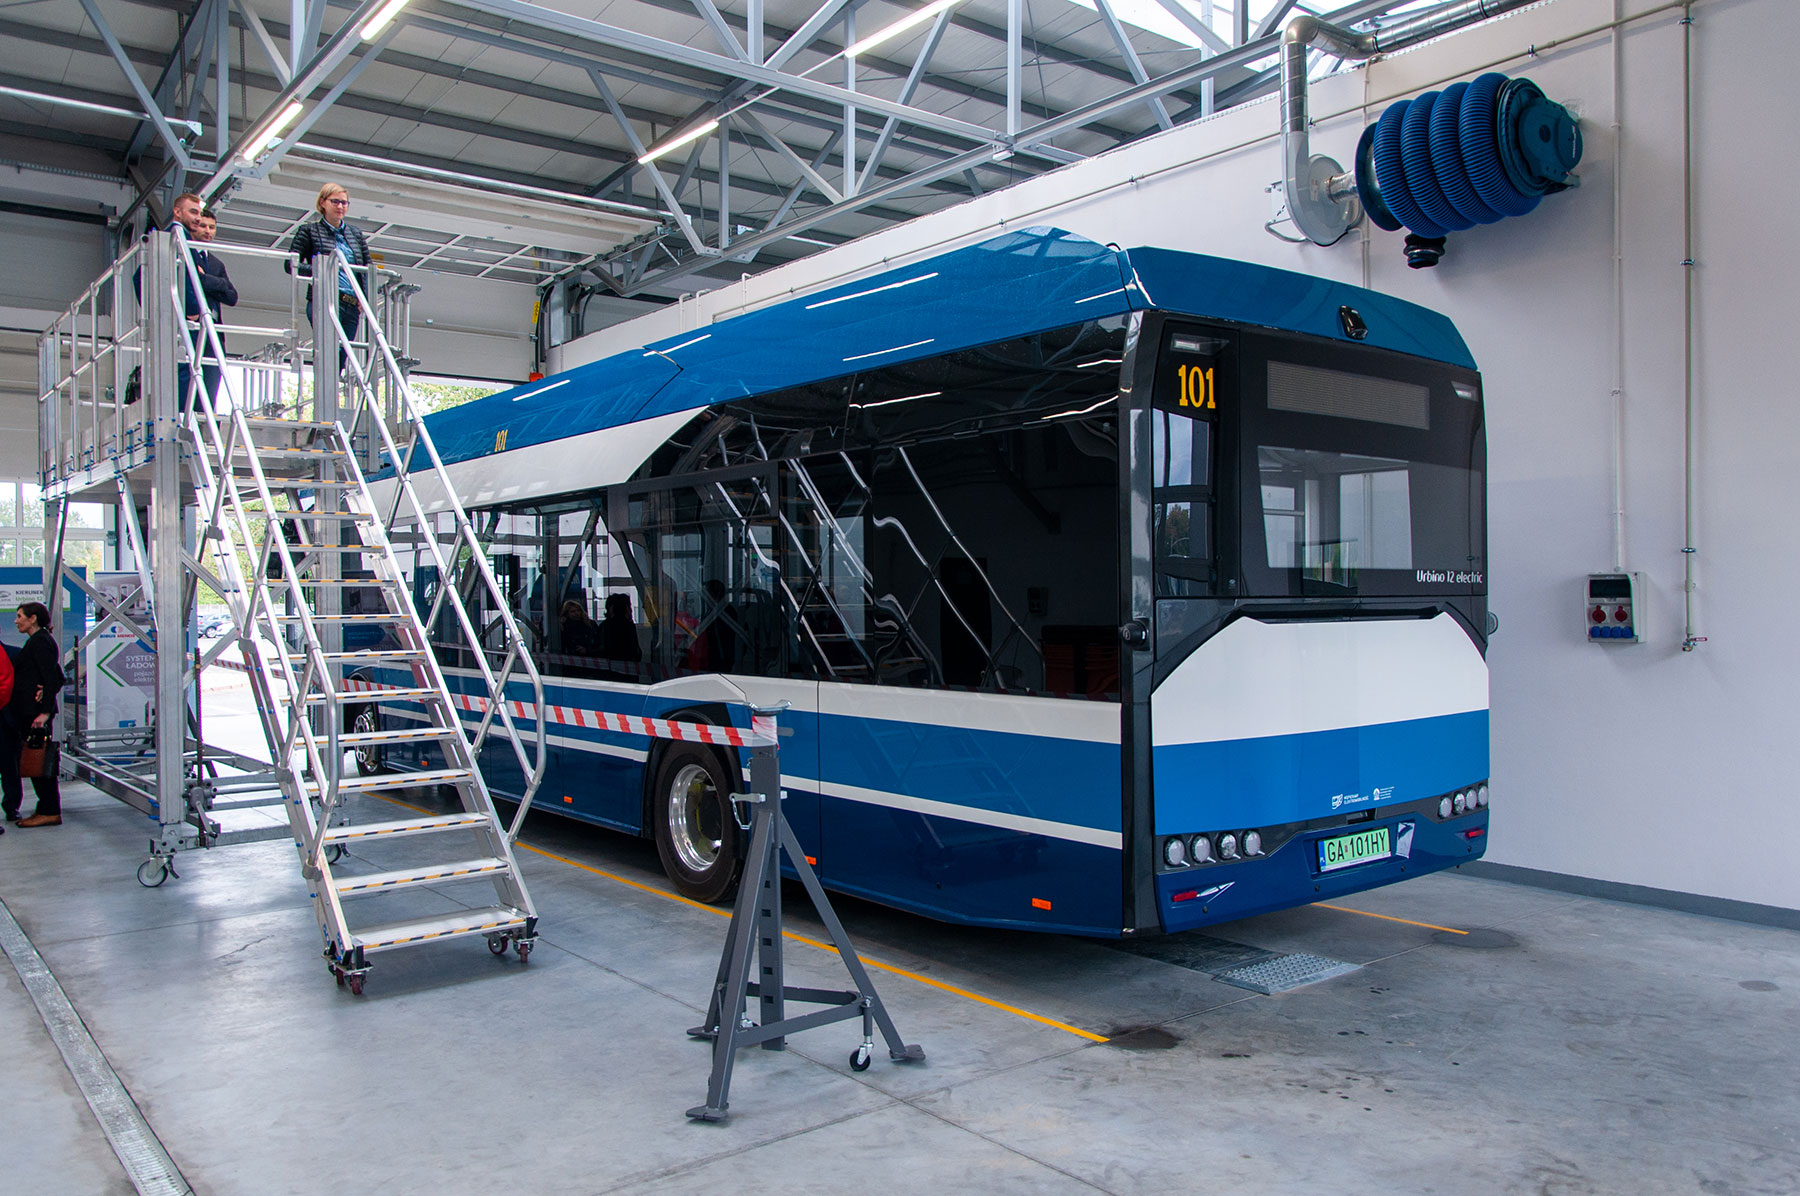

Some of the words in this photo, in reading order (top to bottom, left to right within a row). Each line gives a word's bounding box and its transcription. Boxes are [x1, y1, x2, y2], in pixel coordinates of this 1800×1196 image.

[1178, 364, 1216, 409] 101
[494, 429, 508, 452] 101
[1416, 569, 1445, 583] Urbino
[1446, 570, 1455, 583] 12
[1456, 571, 1483, 584] electric
[1327, 840, 1345, 862] GA
[1349, 831, 1386, 858] 101HY
